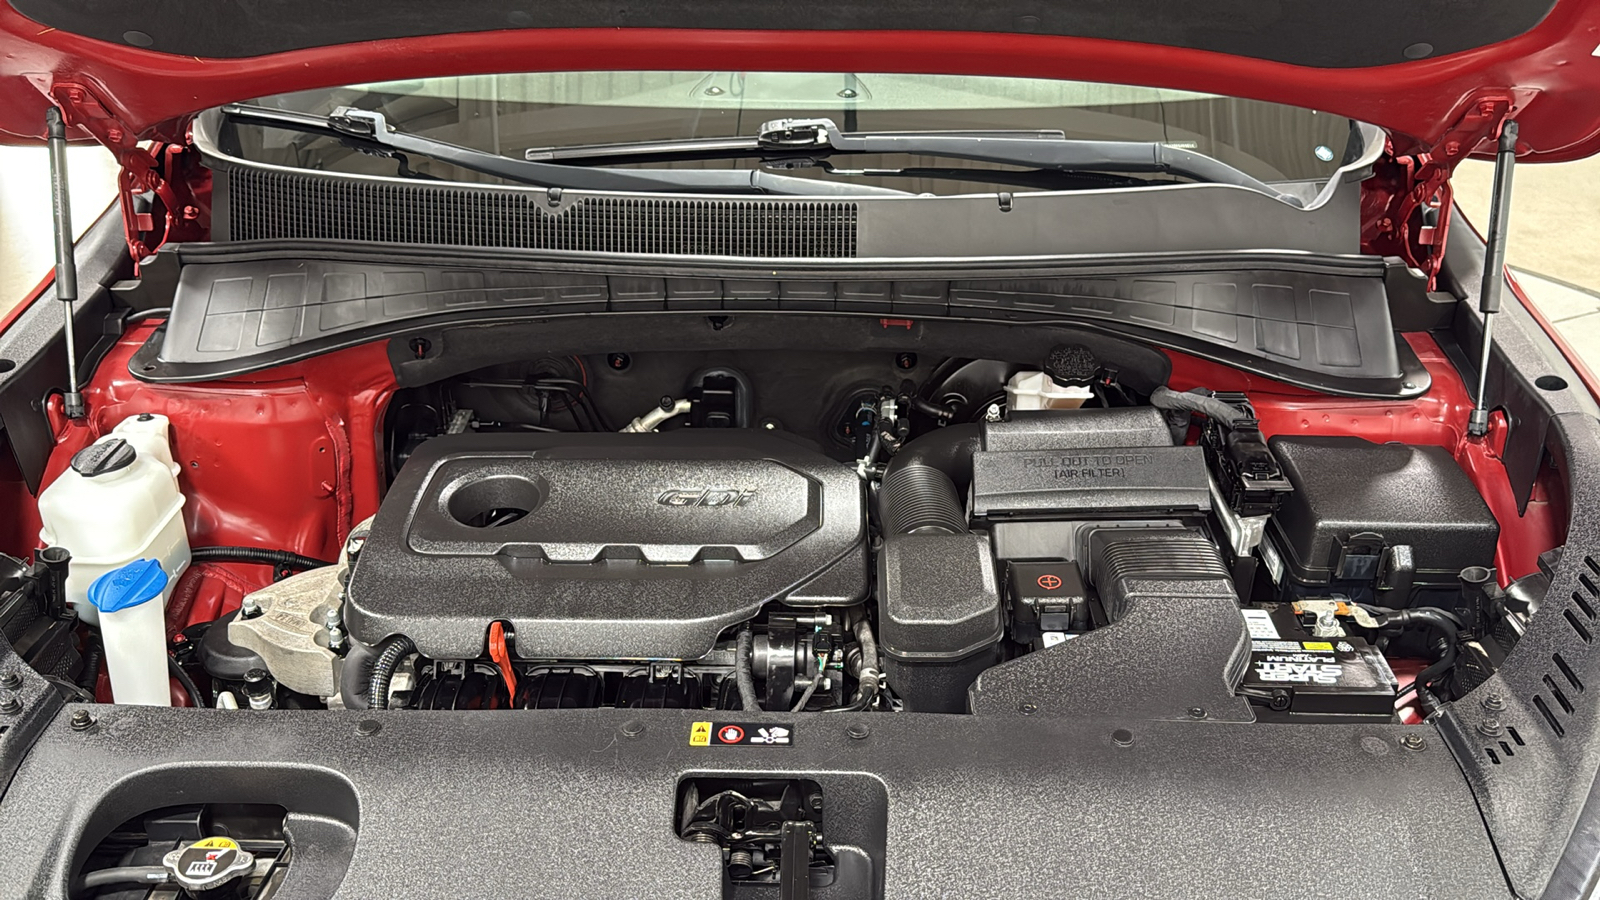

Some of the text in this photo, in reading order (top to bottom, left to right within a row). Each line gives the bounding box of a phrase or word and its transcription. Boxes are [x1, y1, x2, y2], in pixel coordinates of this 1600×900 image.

[1024, 454, 1153, 468] PULL OUT TO OPEN
[1266, 655, 1336, 663] PLATINUM
[1256, 664, 1343, 677] START
[1259, 672, 1337, 684] SUPER
